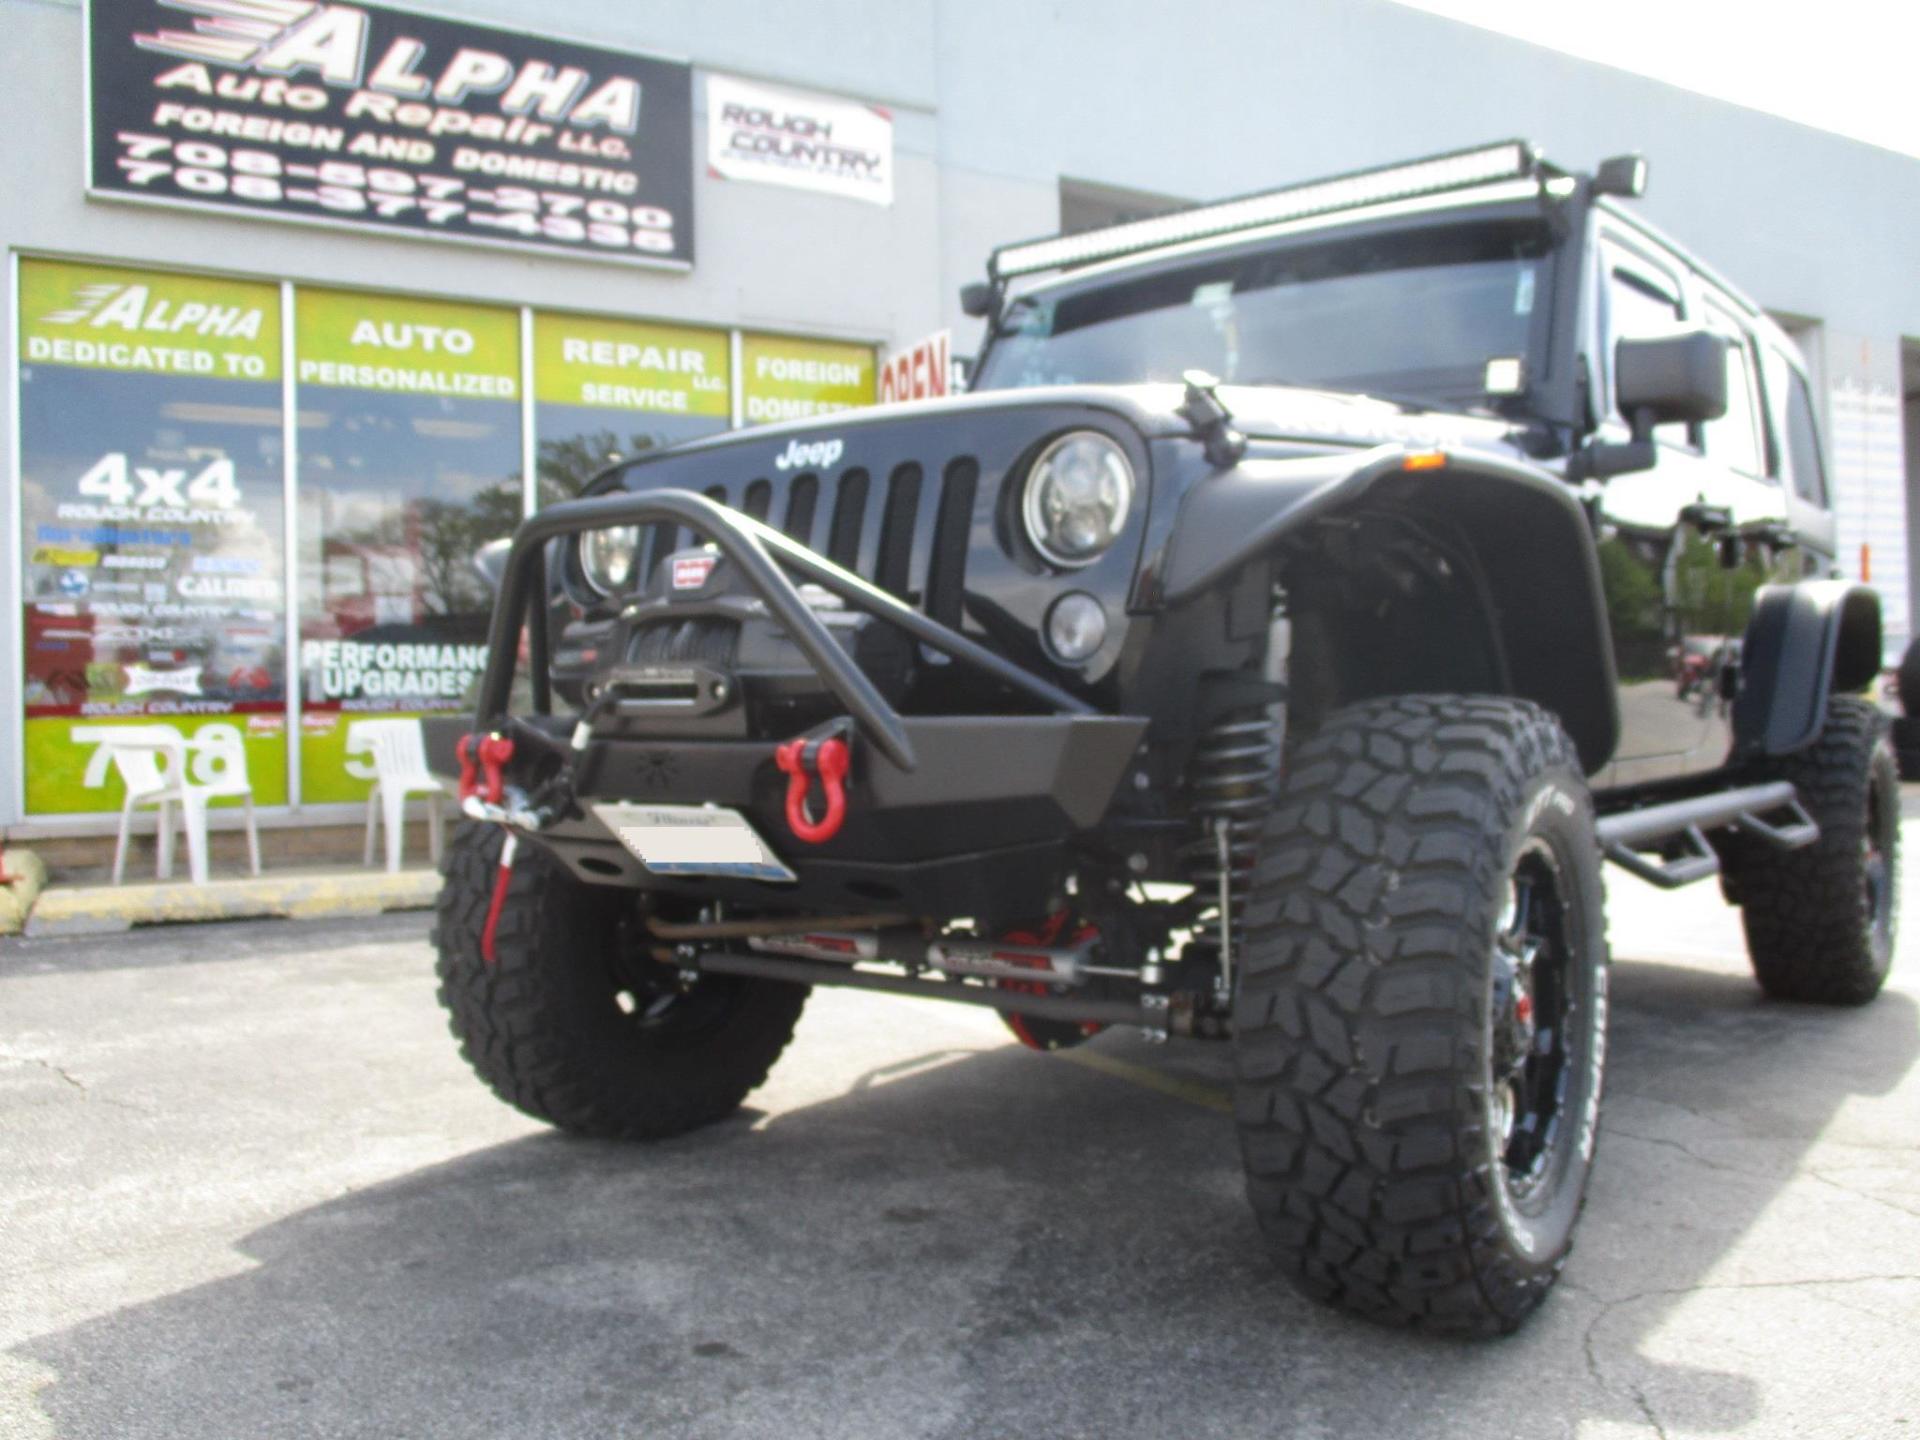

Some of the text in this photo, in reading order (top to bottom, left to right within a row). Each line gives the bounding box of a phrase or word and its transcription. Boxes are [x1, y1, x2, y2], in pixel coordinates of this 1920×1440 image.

[255, 5, 640, 135] ALPHA
[154, 62, 329, 110] Auto
[344, 88, 553, 146] Repair
[721, 101, 832, 140] ROUGH
[153, 101, 639, 195] FOREIGN AND DOMESTIC
[730, 129, 881, 174] COUNTRY
[88, 283, 263, 340] ALPHA
[28, 335, 266, 377] DEDICATED TO
[350, 319, 475, 356] AUTO
[562, 337, 706, 374] REPAIR
[301, 359, 516, 396] PERSONALIZED
[755, 355, 861, 385] FOREIGN
[880, 334, 946, 404] OPEN
[581, 382, 688, 411] SERVICE
[775, 439, 843, 470] Jeep
[78, 452, 243, 510] 4x4
[322, 666, 474, 697] UPGRADES
